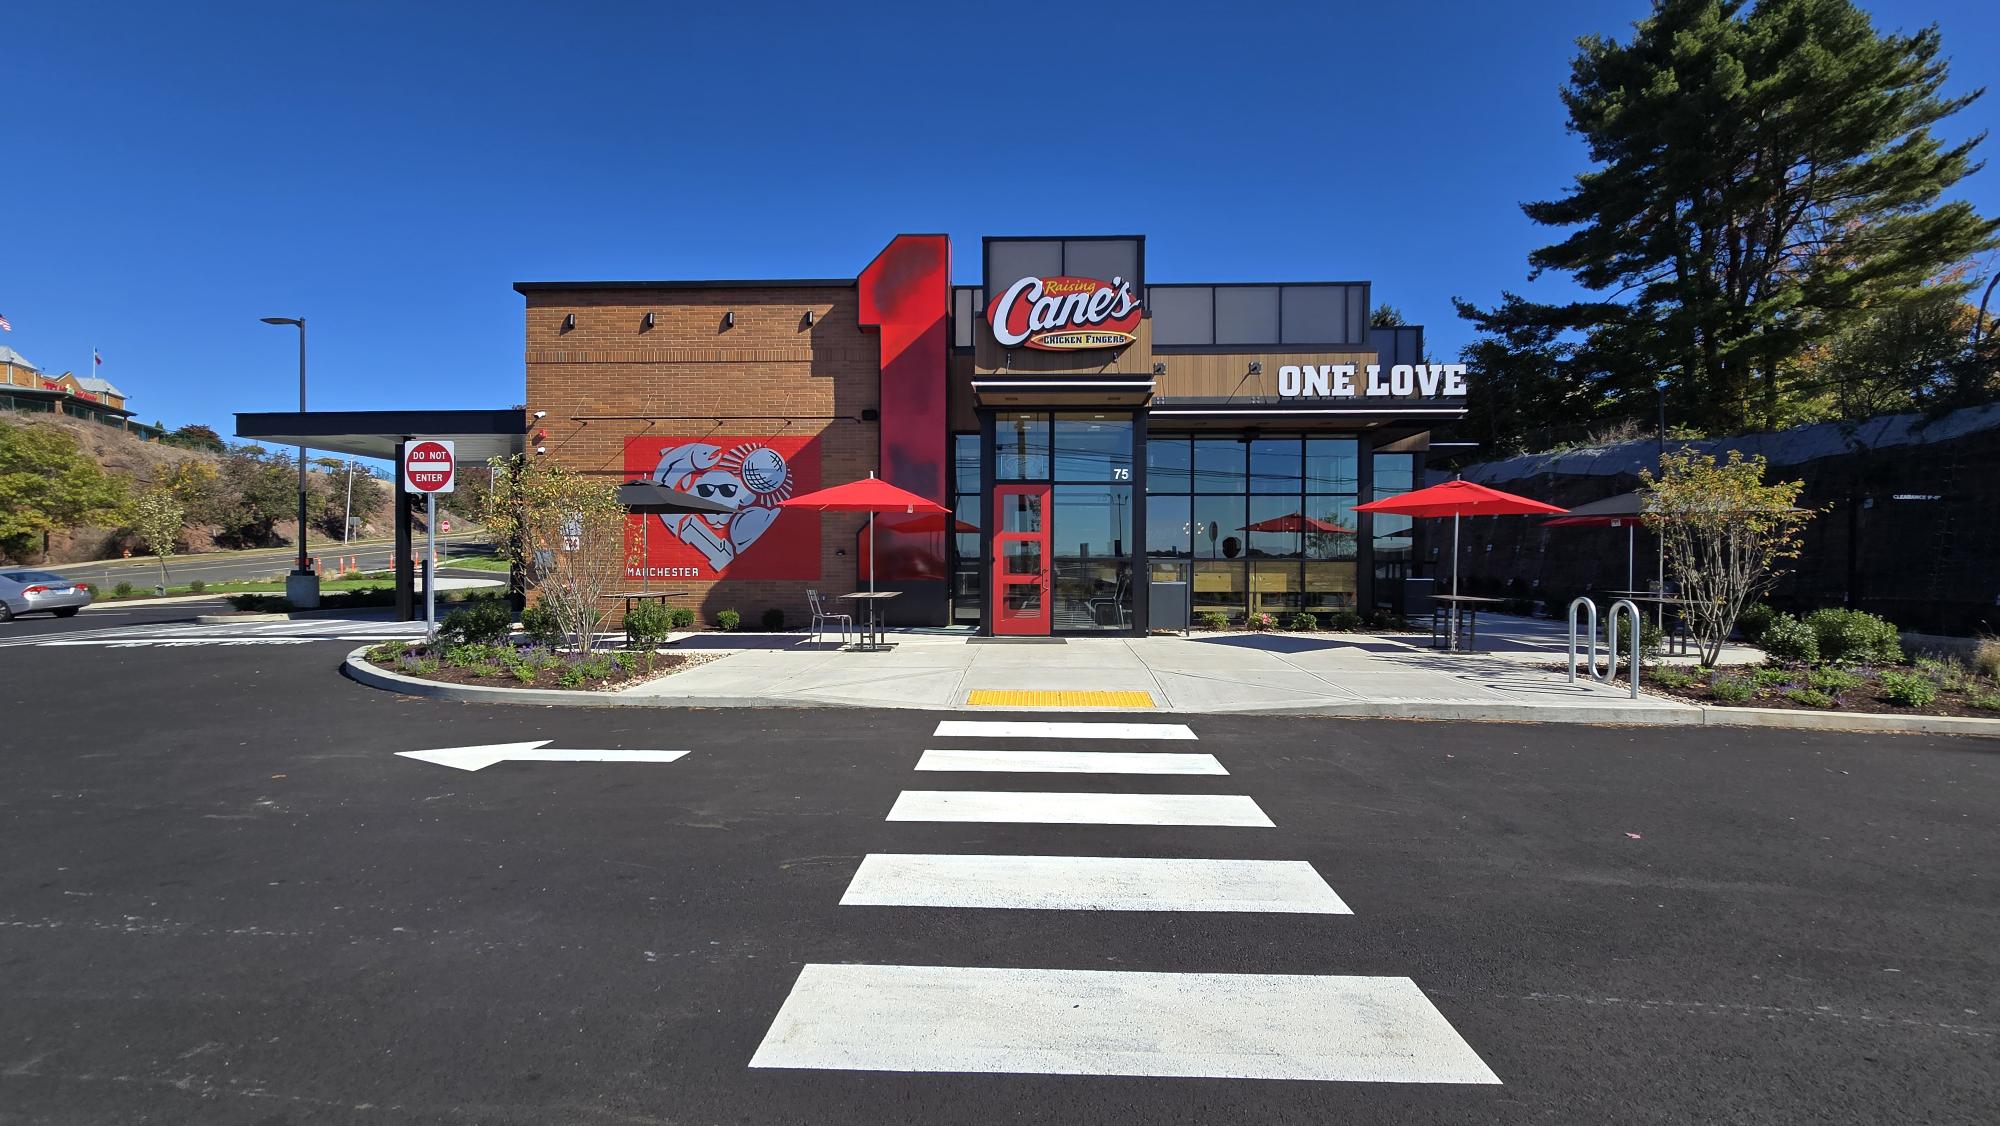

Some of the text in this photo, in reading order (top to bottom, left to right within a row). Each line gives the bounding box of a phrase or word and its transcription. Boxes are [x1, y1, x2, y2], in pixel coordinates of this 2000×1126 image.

[1044, 280, 1096, 294] Raising
[992, 276, 1140, 345] Cane's
[1043, 335, 1125, 344] CHICKEN FINGERS
[1278, 364, 1467, 396] ONE LOVE
[413, 451, 446, 459] DO NOT
[416, 473, 443, 482] ENTER
[1113, 468, 1129, 480] 75
